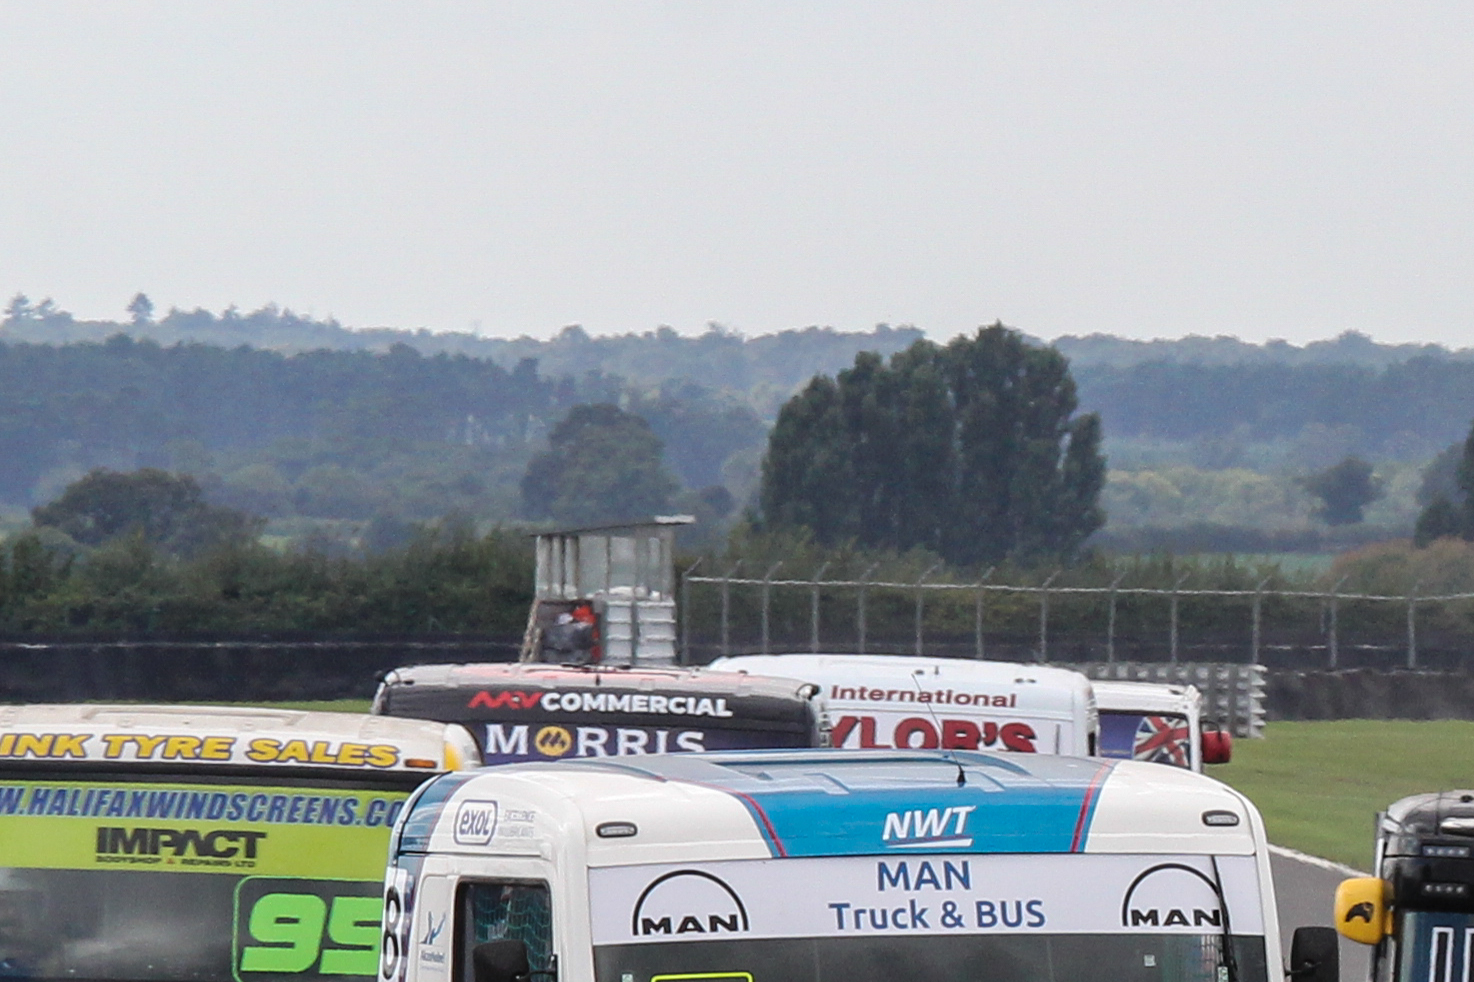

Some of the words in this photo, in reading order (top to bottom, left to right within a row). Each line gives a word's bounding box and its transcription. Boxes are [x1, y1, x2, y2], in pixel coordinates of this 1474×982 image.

[541, 692, 733, 718] COMMERCIAL
[831, 685, 1017, 708] International
[102, 734, 235, 760] TYRE
[246, 738, 399, 768] SALES
[882, 806, 977, 840] NWT
[97, 827, 268, 859] IMPACT
[877, 861, 972, 891] MAN
[642, 914, 738, 935] MAN
[828, 899, 931, 930] Truck
[940, 901, 966, 929] &
[975, 900, 1046, 929] BUS
[1131, 909, 1221, 927] MAN
